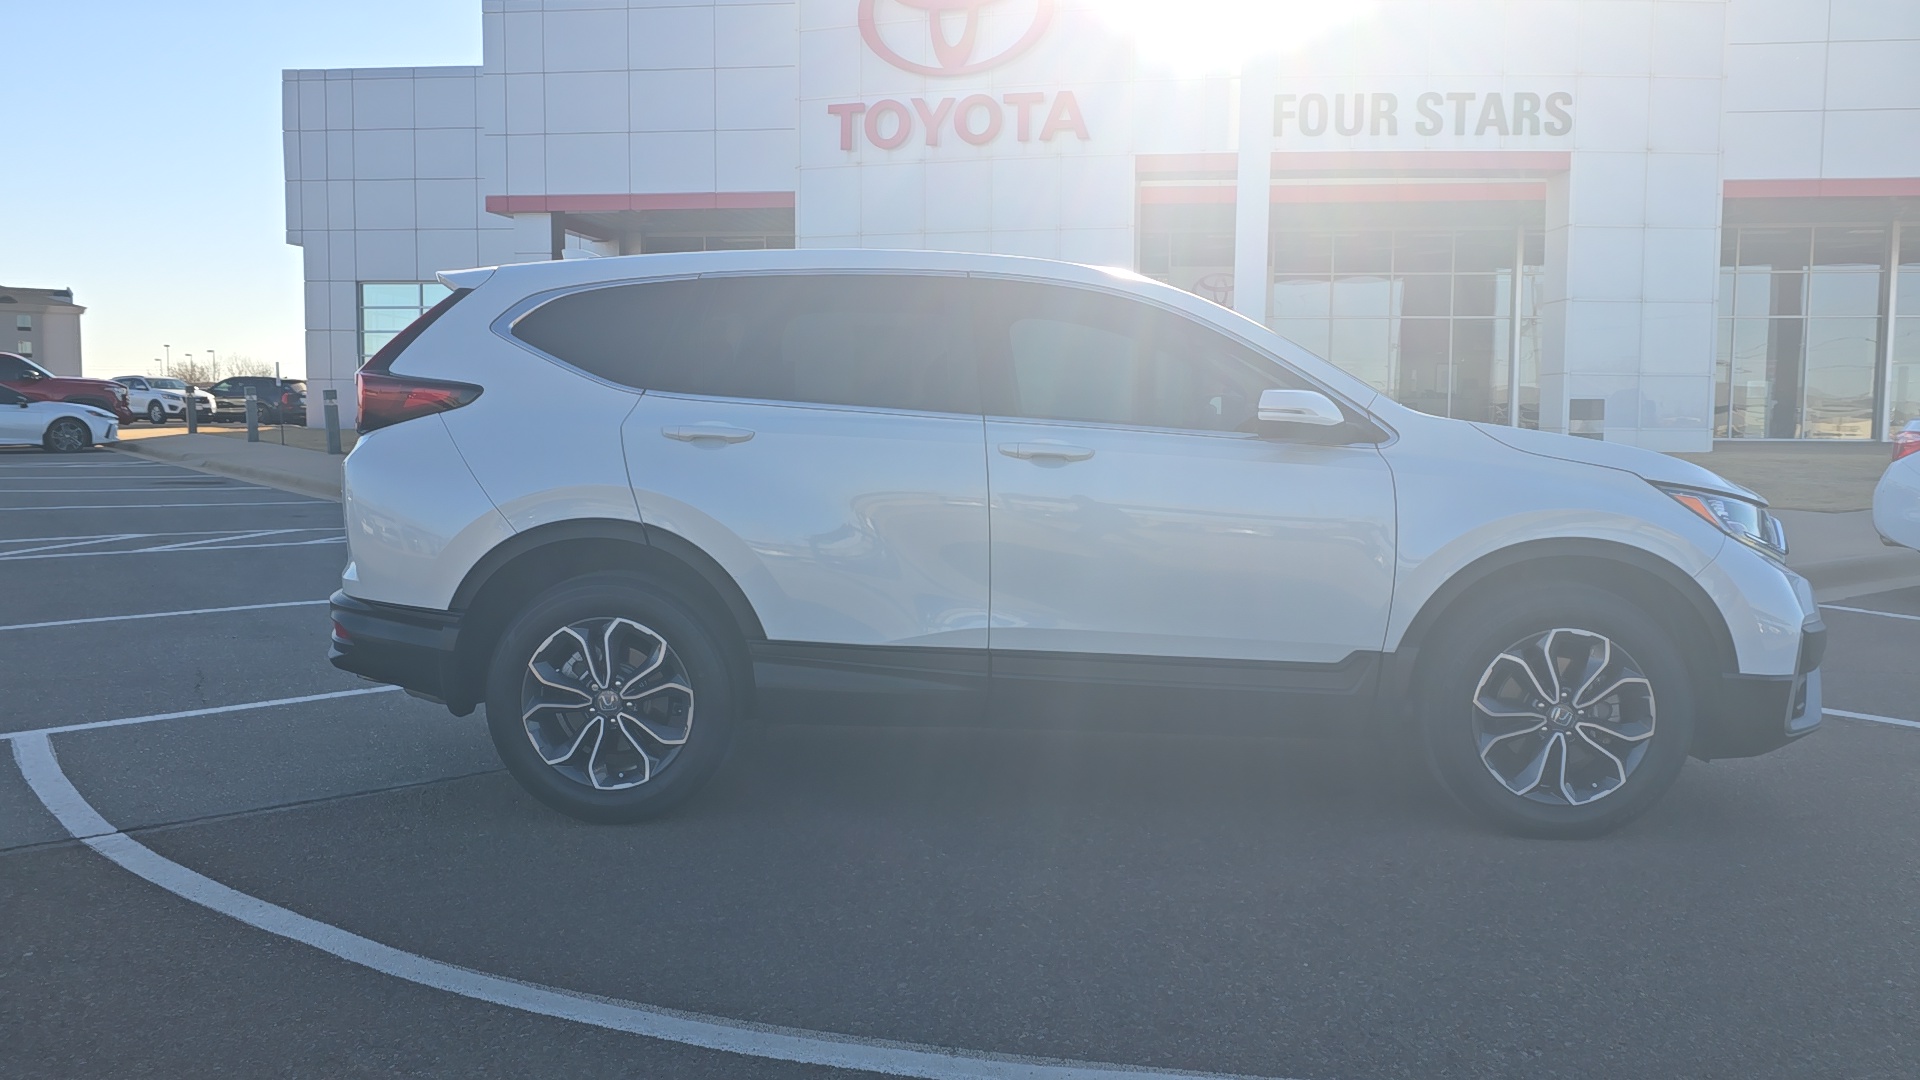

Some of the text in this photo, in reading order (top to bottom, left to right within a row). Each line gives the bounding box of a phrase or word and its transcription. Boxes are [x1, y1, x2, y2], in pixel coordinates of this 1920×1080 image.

[828, 91, 1090, 150] TOYOTA
[1272, 91, 1573, 137] FOUR STARS
